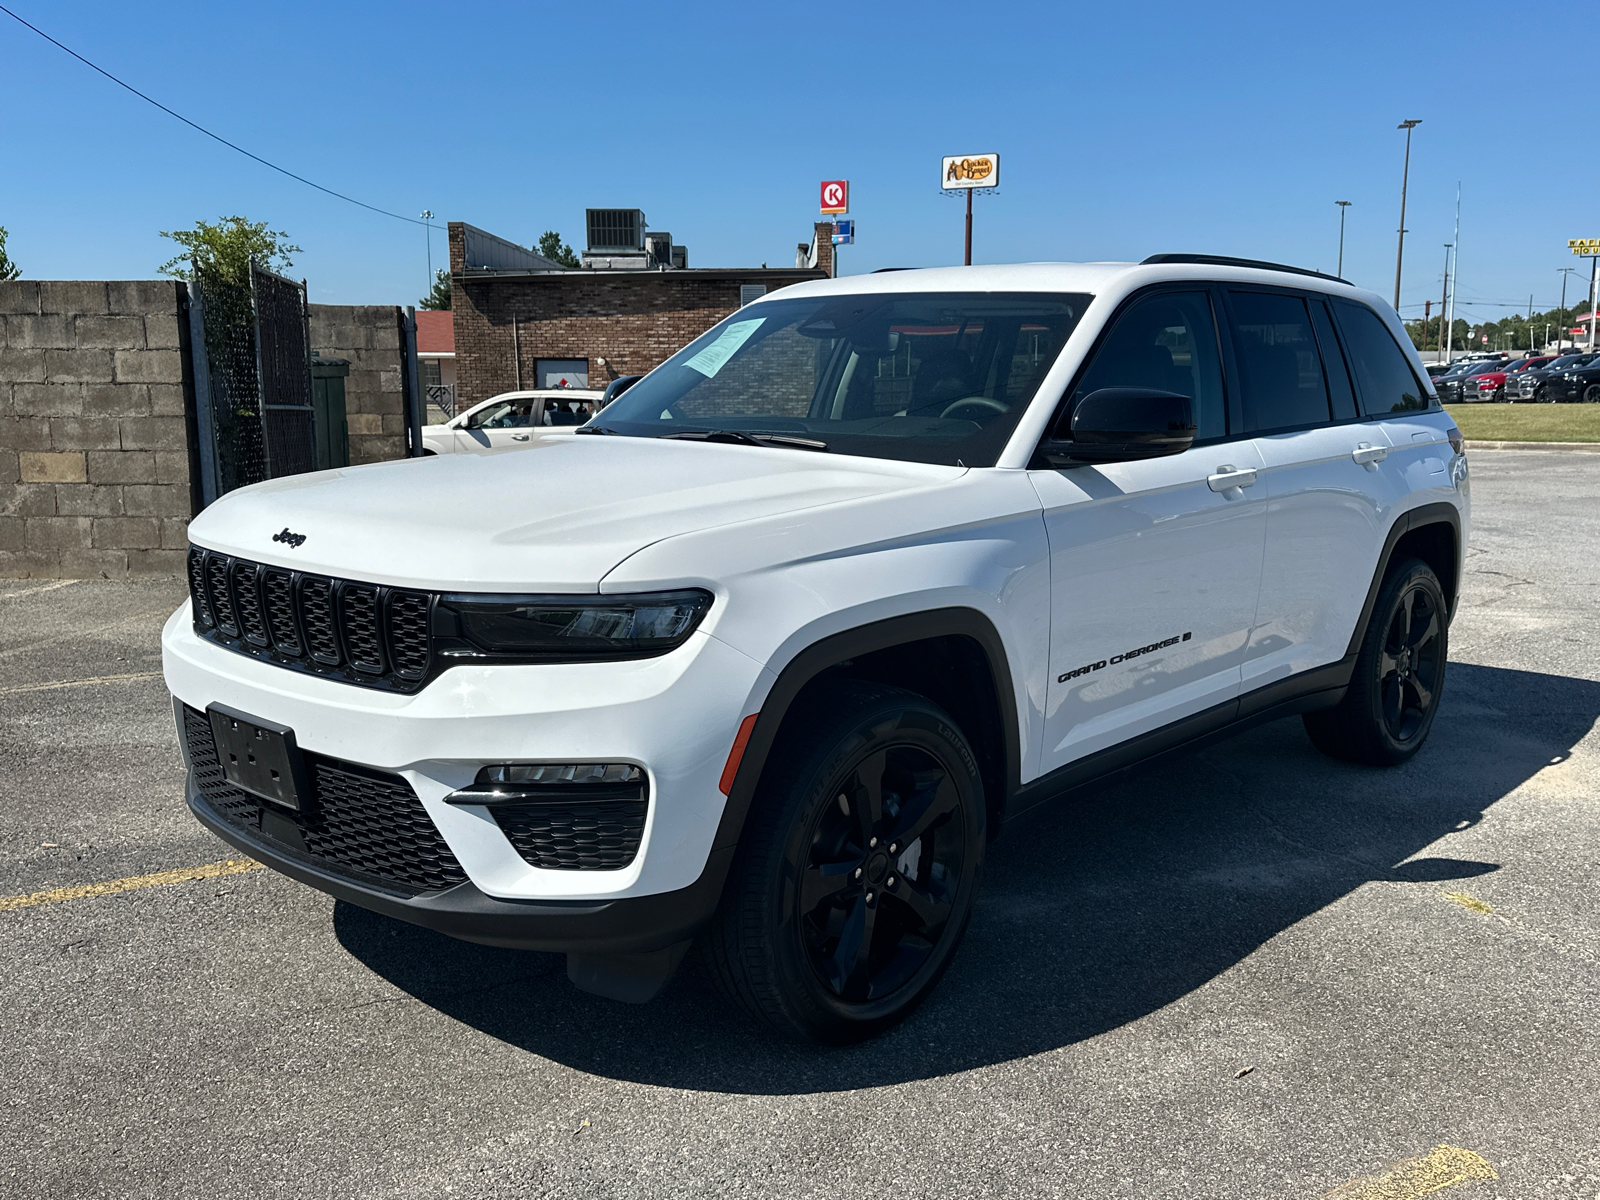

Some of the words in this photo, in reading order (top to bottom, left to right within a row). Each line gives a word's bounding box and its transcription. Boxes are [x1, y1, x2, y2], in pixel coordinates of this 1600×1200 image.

[829, 188, 840, 203] K
[272, 527, 307, 549] Jeep
[1058, 660, 1107, 683] GRAND
[1110, 636, 1180, 665] CHEROKEE
